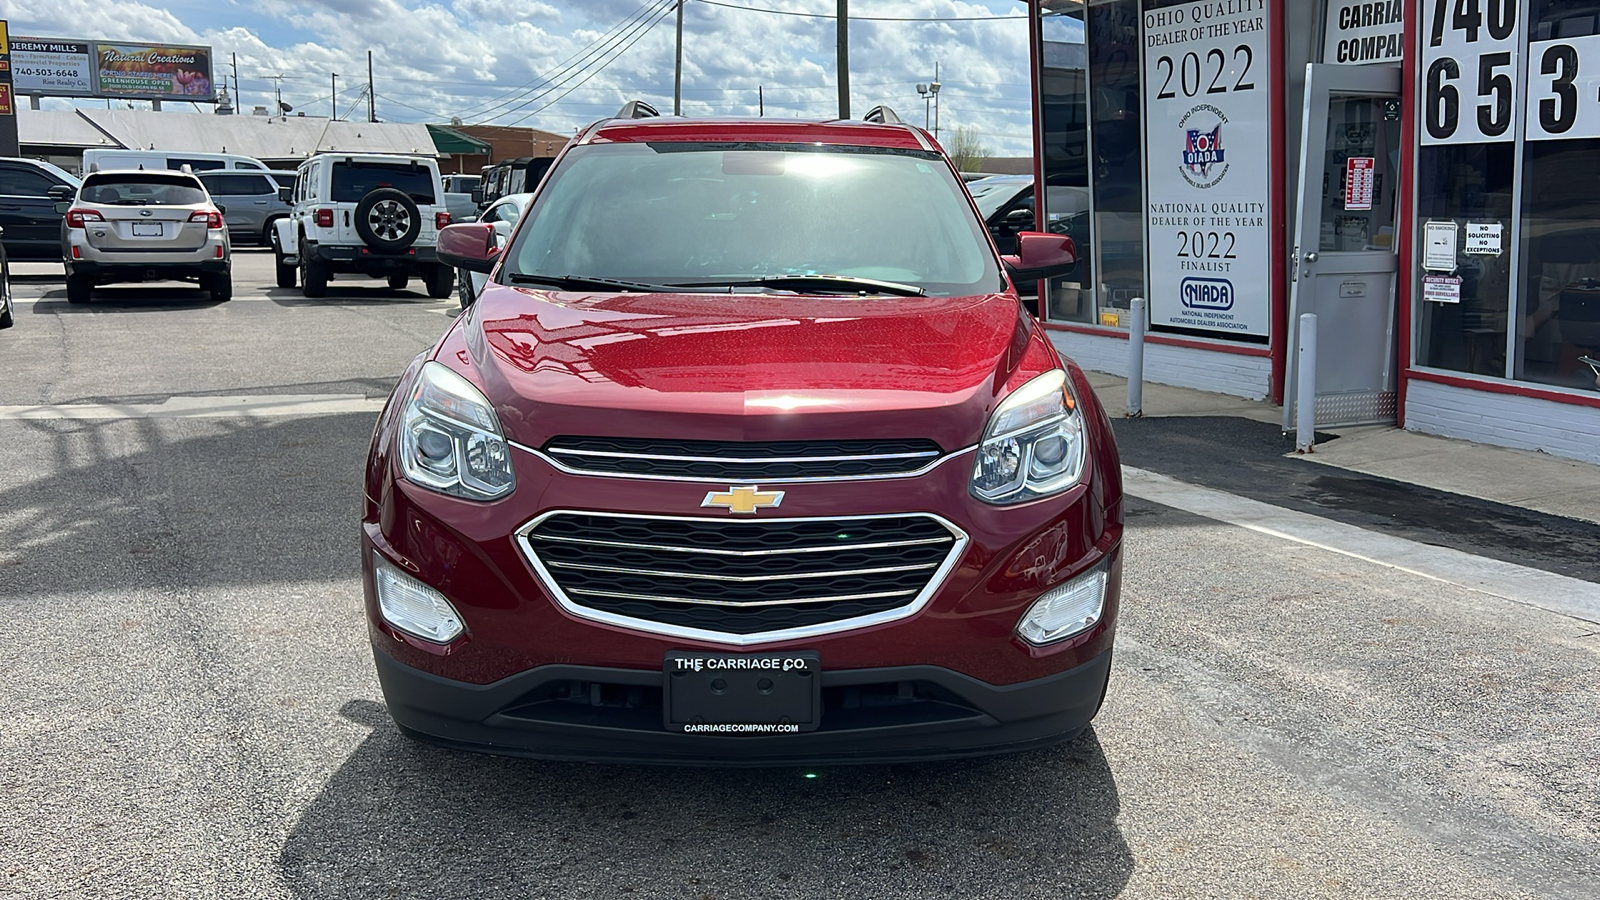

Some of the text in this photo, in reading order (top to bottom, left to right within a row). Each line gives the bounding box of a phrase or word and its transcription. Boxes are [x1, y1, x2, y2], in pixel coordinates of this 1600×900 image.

[1146, 10, 1184, 29] OHIO
[1192, 0, 1264, 24] QUALITY
[1340, 0, 1402, 30] CARRIA
[1148, 30, 1188, 47] DEALER
[1191, 27, 1205, 40] OF
[1207, 23, 1230, 38] THE
[1232, 18, 1264, 34] YEAR
[11, 42, 48, 51] JEREMY
[103, 50, 195, 64] Natural Creations
[15, 68, 78, 77] 740-503-6648
[1157, 44, 1254, 99] 2022
[1178, 104, 1228, 128] OHIO INDEPENDENT
[1188, 151, 1217, 163] OIADA
[1150, 203, 1264, 214] NATIONAL QUALITY
[1152, 217, 1263, 226] DEALER OF THE YEAR
[1177, 231, 1236, 259] 2022
[1181, 261, 1231, 272] FINALIST
[1185, 284, 1229, 303] NIADA
[675, 659, 807, 669] THE CARRIAGE CO.
